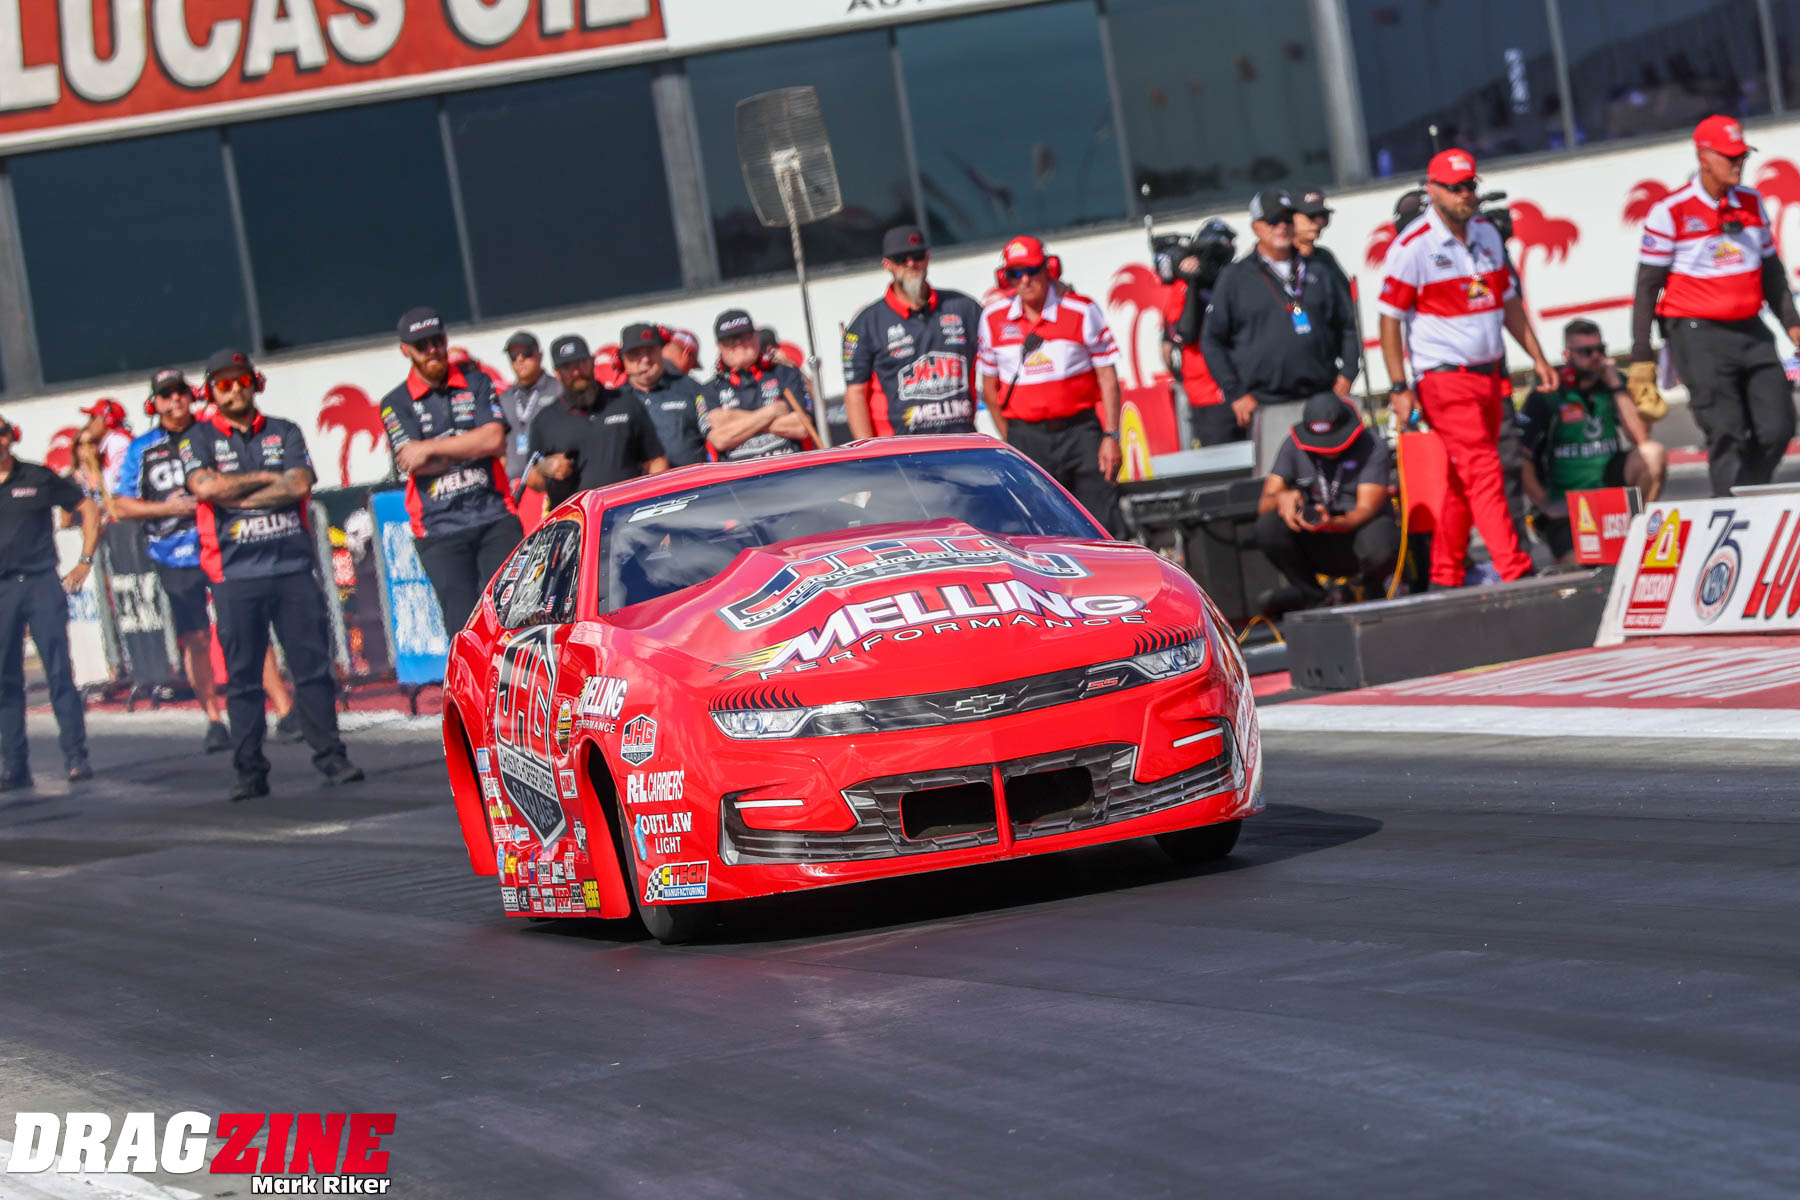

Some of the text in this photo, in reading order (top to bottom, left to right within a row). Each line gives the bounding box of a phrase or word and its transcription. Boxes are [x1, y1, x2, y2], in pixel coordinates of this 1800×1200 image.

[760, 579, 1148, 671] MELLING
[758, 614, 1148, 681] PERFORMANCE
[577, 675, 628, 720] MELLING
[623, 719, 656, 745] JHG
[647, 770, 684, 802] CARRIERS
[512, 780, 556, 830] GARAGE
[640, 812, 692, 835] OUTLAW
[655, 836, 681, 855] LIGHT
[664, 886, 705, 898] MANUFACTURING
